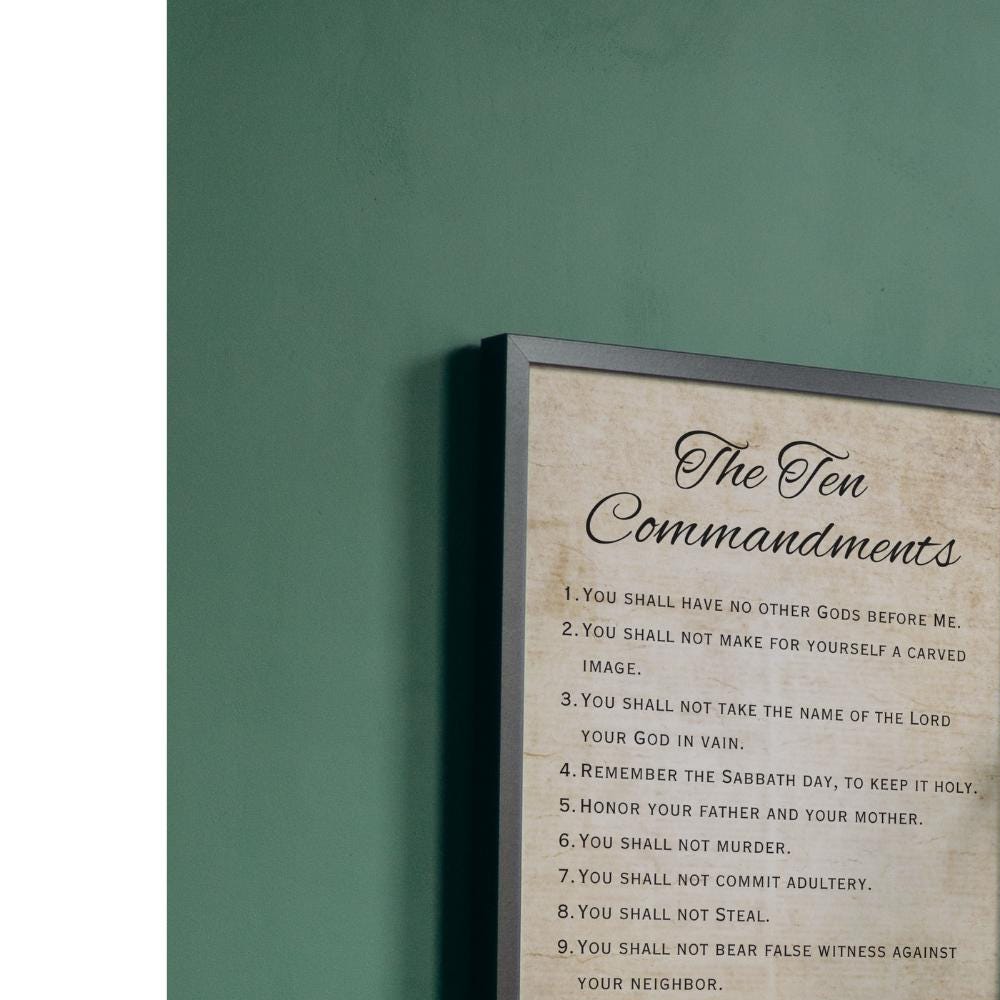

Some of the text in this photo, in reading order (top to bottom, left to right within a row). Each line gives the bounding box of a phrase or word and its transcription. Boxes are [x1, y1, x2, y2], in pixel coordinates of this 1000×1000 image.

[674, 429, 869, 500] The Ten
[585, 491, 962, 568] Commandments
[564, 585, 961, 629] 1. YOU SHALL HAVE NO OTHER GODS BEFORE ME.
[561, 621, 966, 662] 2. YOU SHALL NOT MAKE FOR YOURSELF A CARVED
[583, 659, 641, 676] IMAGE.
[560, 691, 951, 727] 3. YOU SHALL NOT TAKE THE NAME OF THE LORD
[580, 729, 744, 750] YOUR GOD IN VAIN.
[559, 762, 978, 795] 4. REMEMBER THE SABBATH DAY, TO KEEP IT HOLY.
[559, 797, 923, 826] 5. HONOR YOUR FATHER AND YOUR MOTHER.
[558, 832, 791, 855] 6. YOU SHALL NOT MURDER.
[558, 868, 872, 891] 7. YOU SHALL NOT COMMIT ADULTERY.
[557, 903, 770, 923] 8. YOU SHALL NOT STEAL.
[557, 938, 958, 959] 9. YOU SHALL NOT BEAR FALSE WITNESS AGAINST
[577, 977, 723, 991] YOUR NEIGHBOR.
